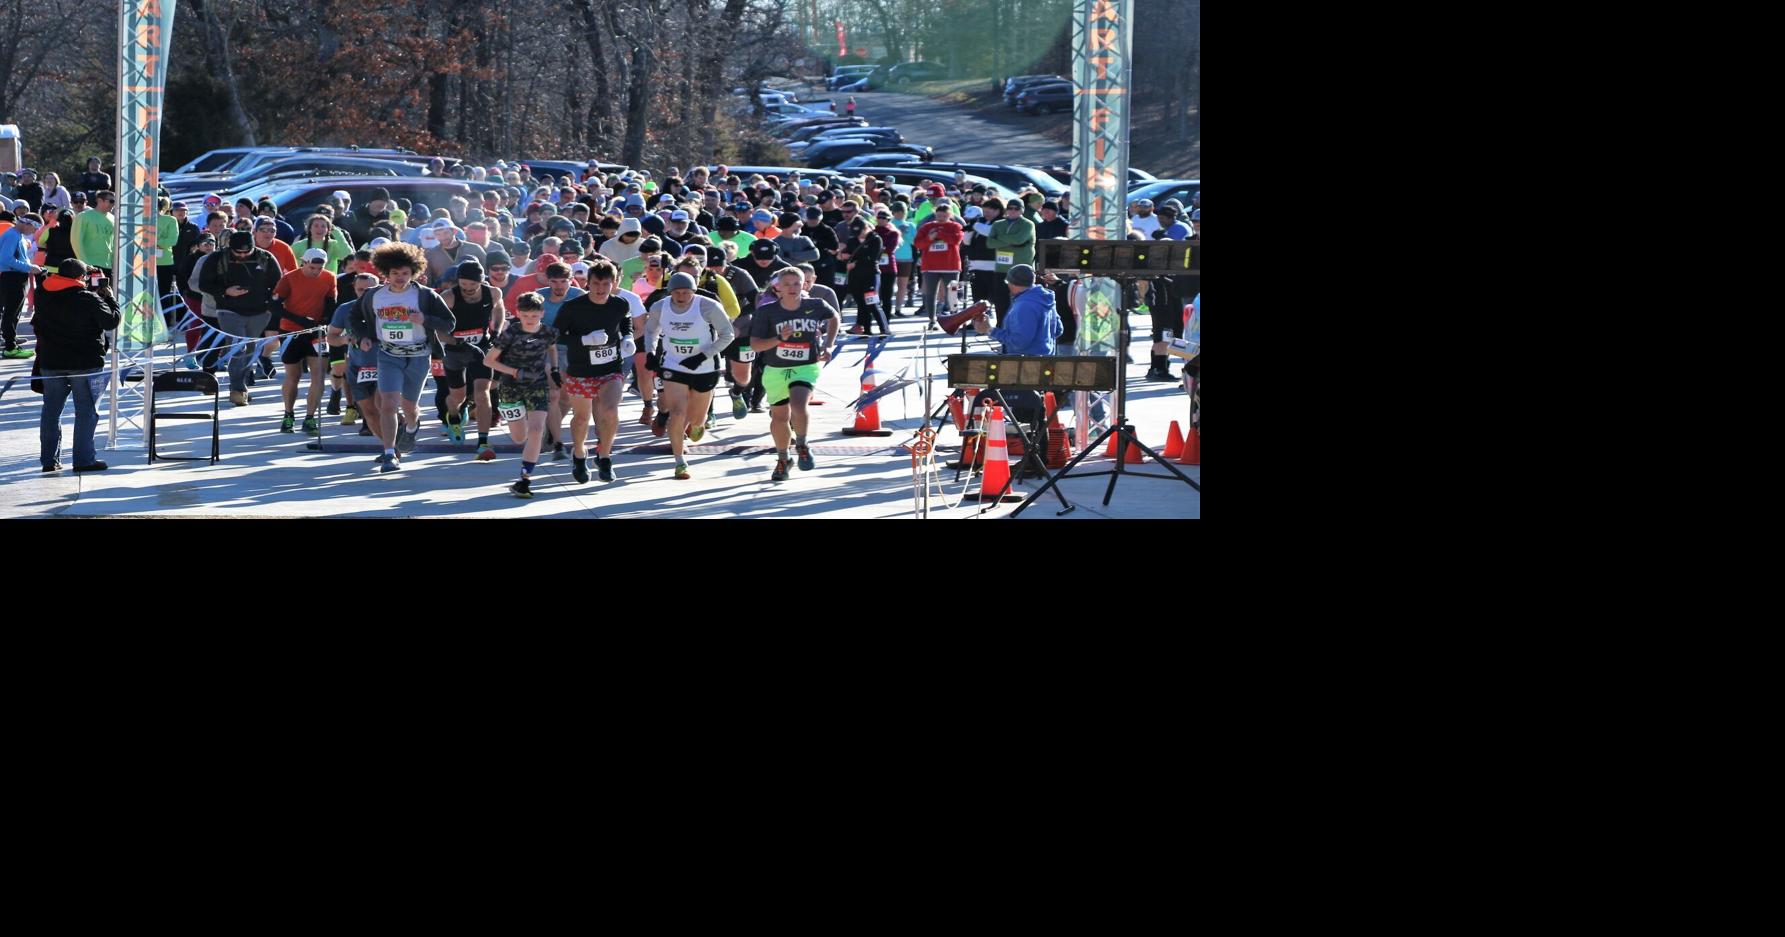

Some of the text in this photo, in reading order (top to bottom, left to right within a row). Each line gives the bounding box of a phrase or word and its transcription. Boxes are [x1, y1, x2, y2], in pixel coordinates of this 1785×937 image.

[389, 331, 404, 340] 50
[594, 348, 614, 359] 680
[675, 346, 694, 354] 157
[782, 349, 804, 359] 348
[501, 408, 522, 419] 193
